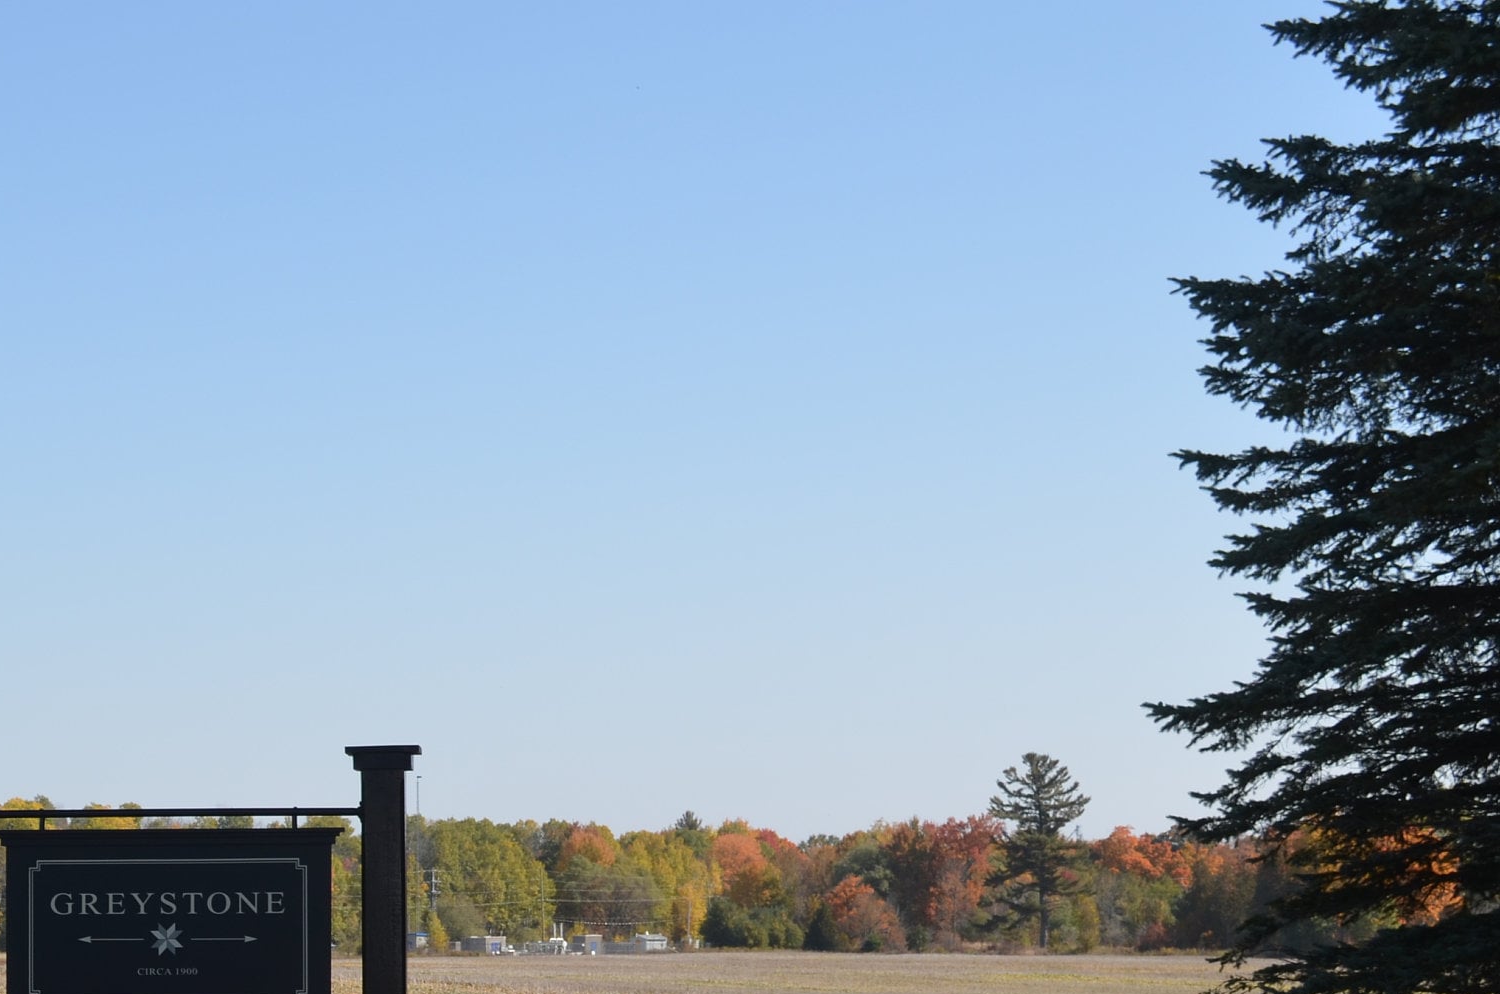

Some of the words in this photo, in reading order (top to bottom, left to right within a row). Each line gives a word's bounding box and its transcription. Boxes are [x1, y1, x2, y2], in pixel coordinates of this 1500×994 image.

[49, 891, 286, 916] GREYSTONE
[137, 967, 172, 976] CIRCA
[175, 967, 198, 976] 1900
